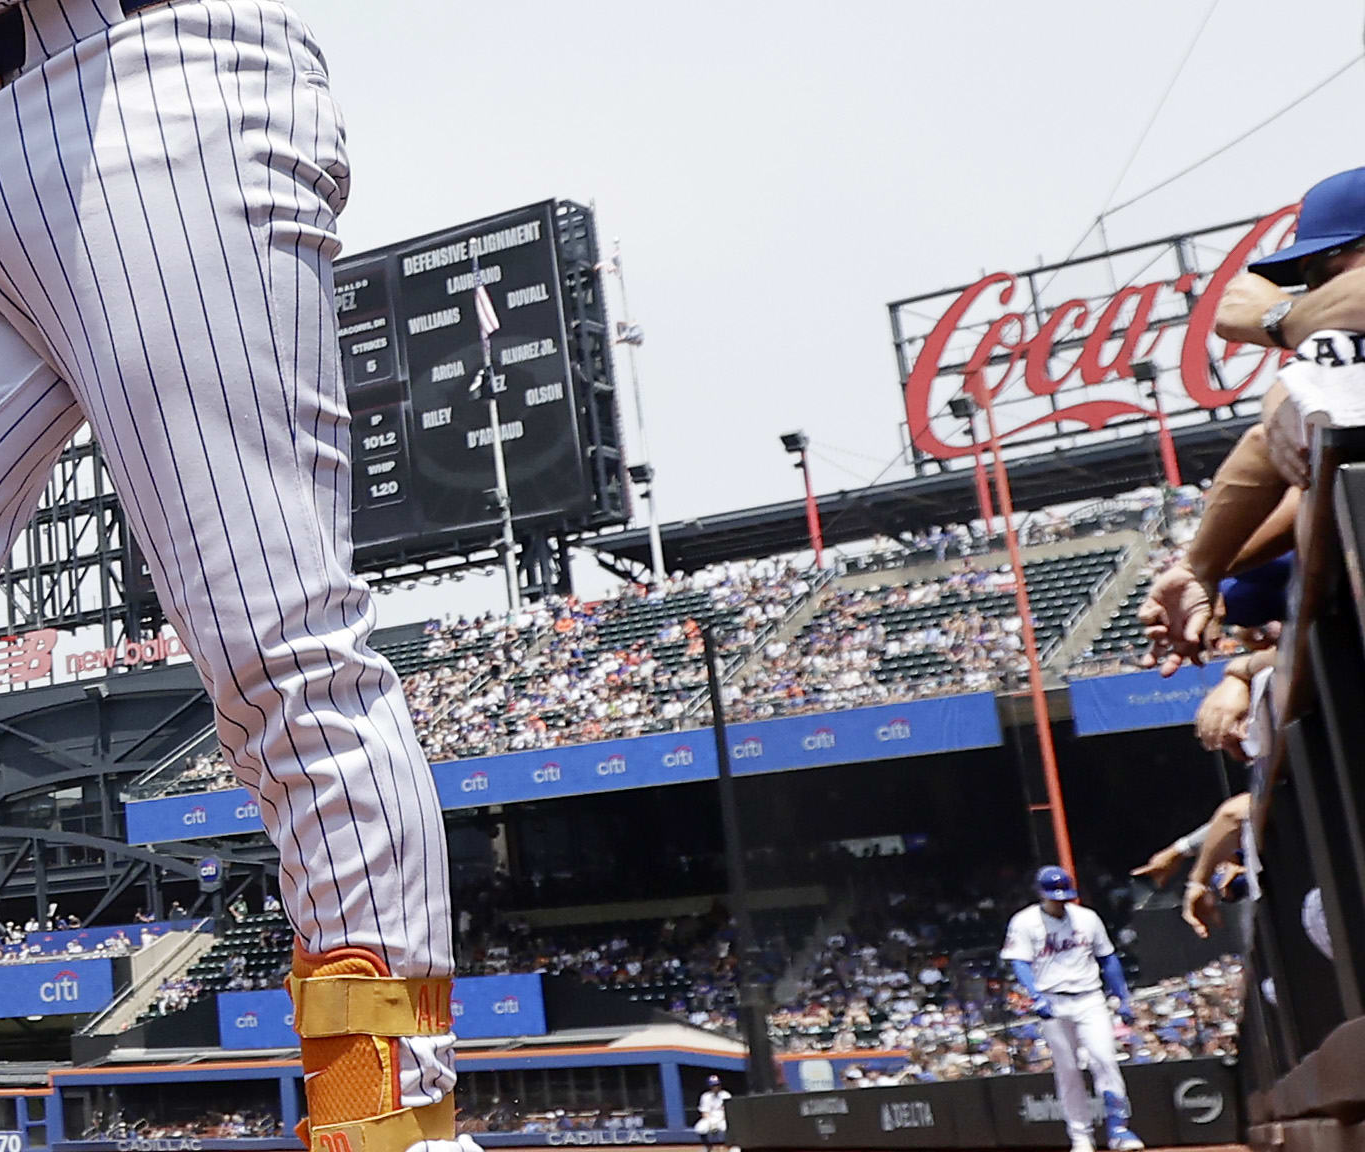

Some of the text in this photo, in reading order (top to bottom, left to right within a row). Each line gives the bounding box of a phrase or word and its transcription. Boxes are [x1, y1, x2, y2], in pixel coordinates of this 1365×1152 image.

[403, 221, 541, 277] DEFENSIVE ALIGNMENT
[446, 265, 502, 295] LAURANO
[507, 283, 549, 309] DUVALL
[408, 307, 461, 335] WILLIAMS
[906, 203, 1303, 458] Coca-C
[500, 341, 540, 366] ALVAREZ
[432, 360, 465, 382] ARCIA
[525, 382, 563, 406] OLSON
[422, 407, 452, 429] RILEY
[467, 421, 524, 448] D'ARAUD
[66, 646, 118, 675] new
[663, 749, 693, 768] citi
[733, 740, 762, 759] citi
[533, 765, 561, 783] citi
[596, 758, 626, 776] citi
[461, 773, 488, 791] citi
[182, 811, 206, 825] citi
[235, 804, 258, 819] citi
[40, 976, 79, 1002] citi
[235, 1013, 258, 1028] citi
[117, 1140, 202, 1152] CADILLAC
[546, 1128, 657, 1145] CADILLAC
